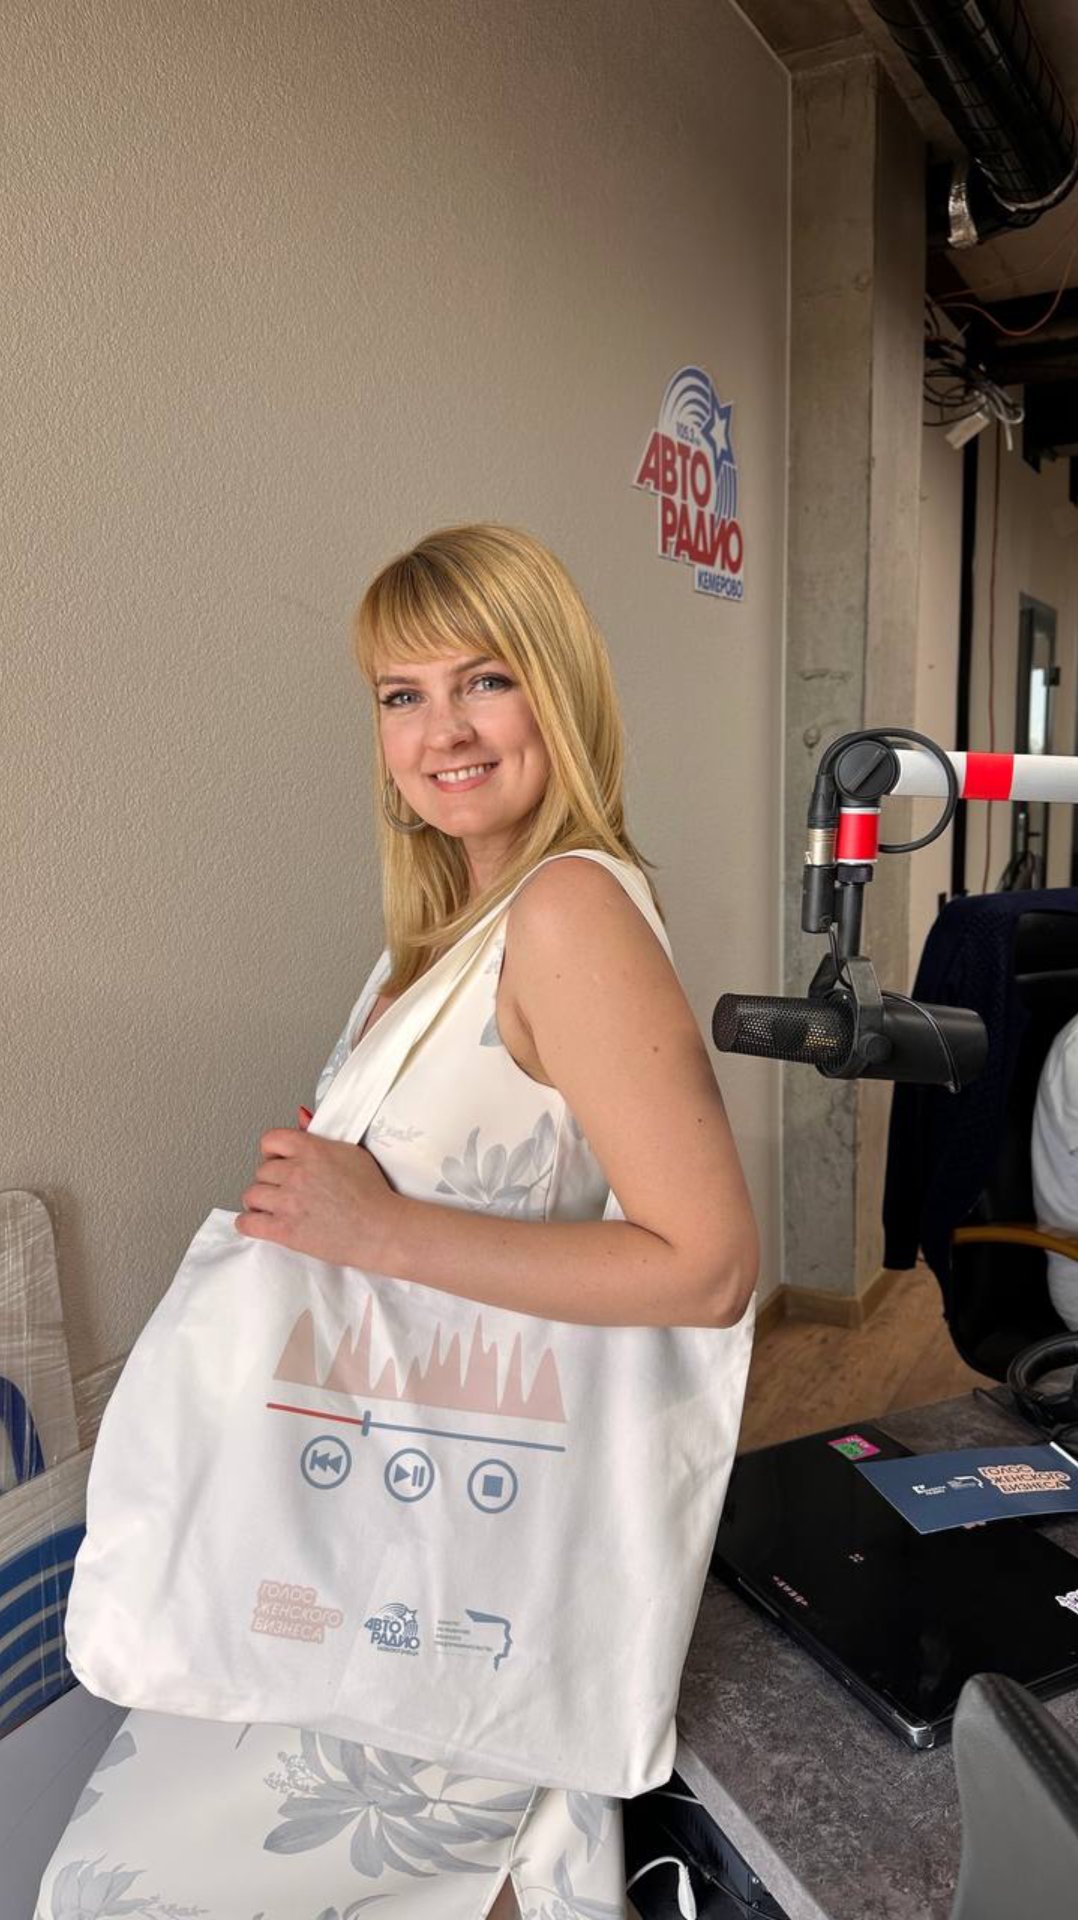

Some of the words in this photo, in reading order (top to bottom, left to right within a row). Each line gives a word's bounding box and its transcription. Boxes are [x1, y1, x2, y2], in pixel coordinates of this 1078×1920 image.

[637, 431, 712, 508] АВТО
[661, 496, 743, 575] РАДИО
[697, 570, 743, 598] КЕМЕРОВО
[982, 1465, 1031, 1476] ГОЛОС
[994, 1472, 1067, 1483] ЖЕНСКОГО
[1001, 1481, 1065, 1492] БИЗНЕСА
[259, 1582, 316, 1604] ГОЛОС
[256, 1602, 340, 1626] ЖЕНСКОГО
[254, 1617, 322, 1640] БИЗНЕСА
[364, 1617, 402, 1634] АВТО
[370, 1631, 420, 1650] РАДИО
